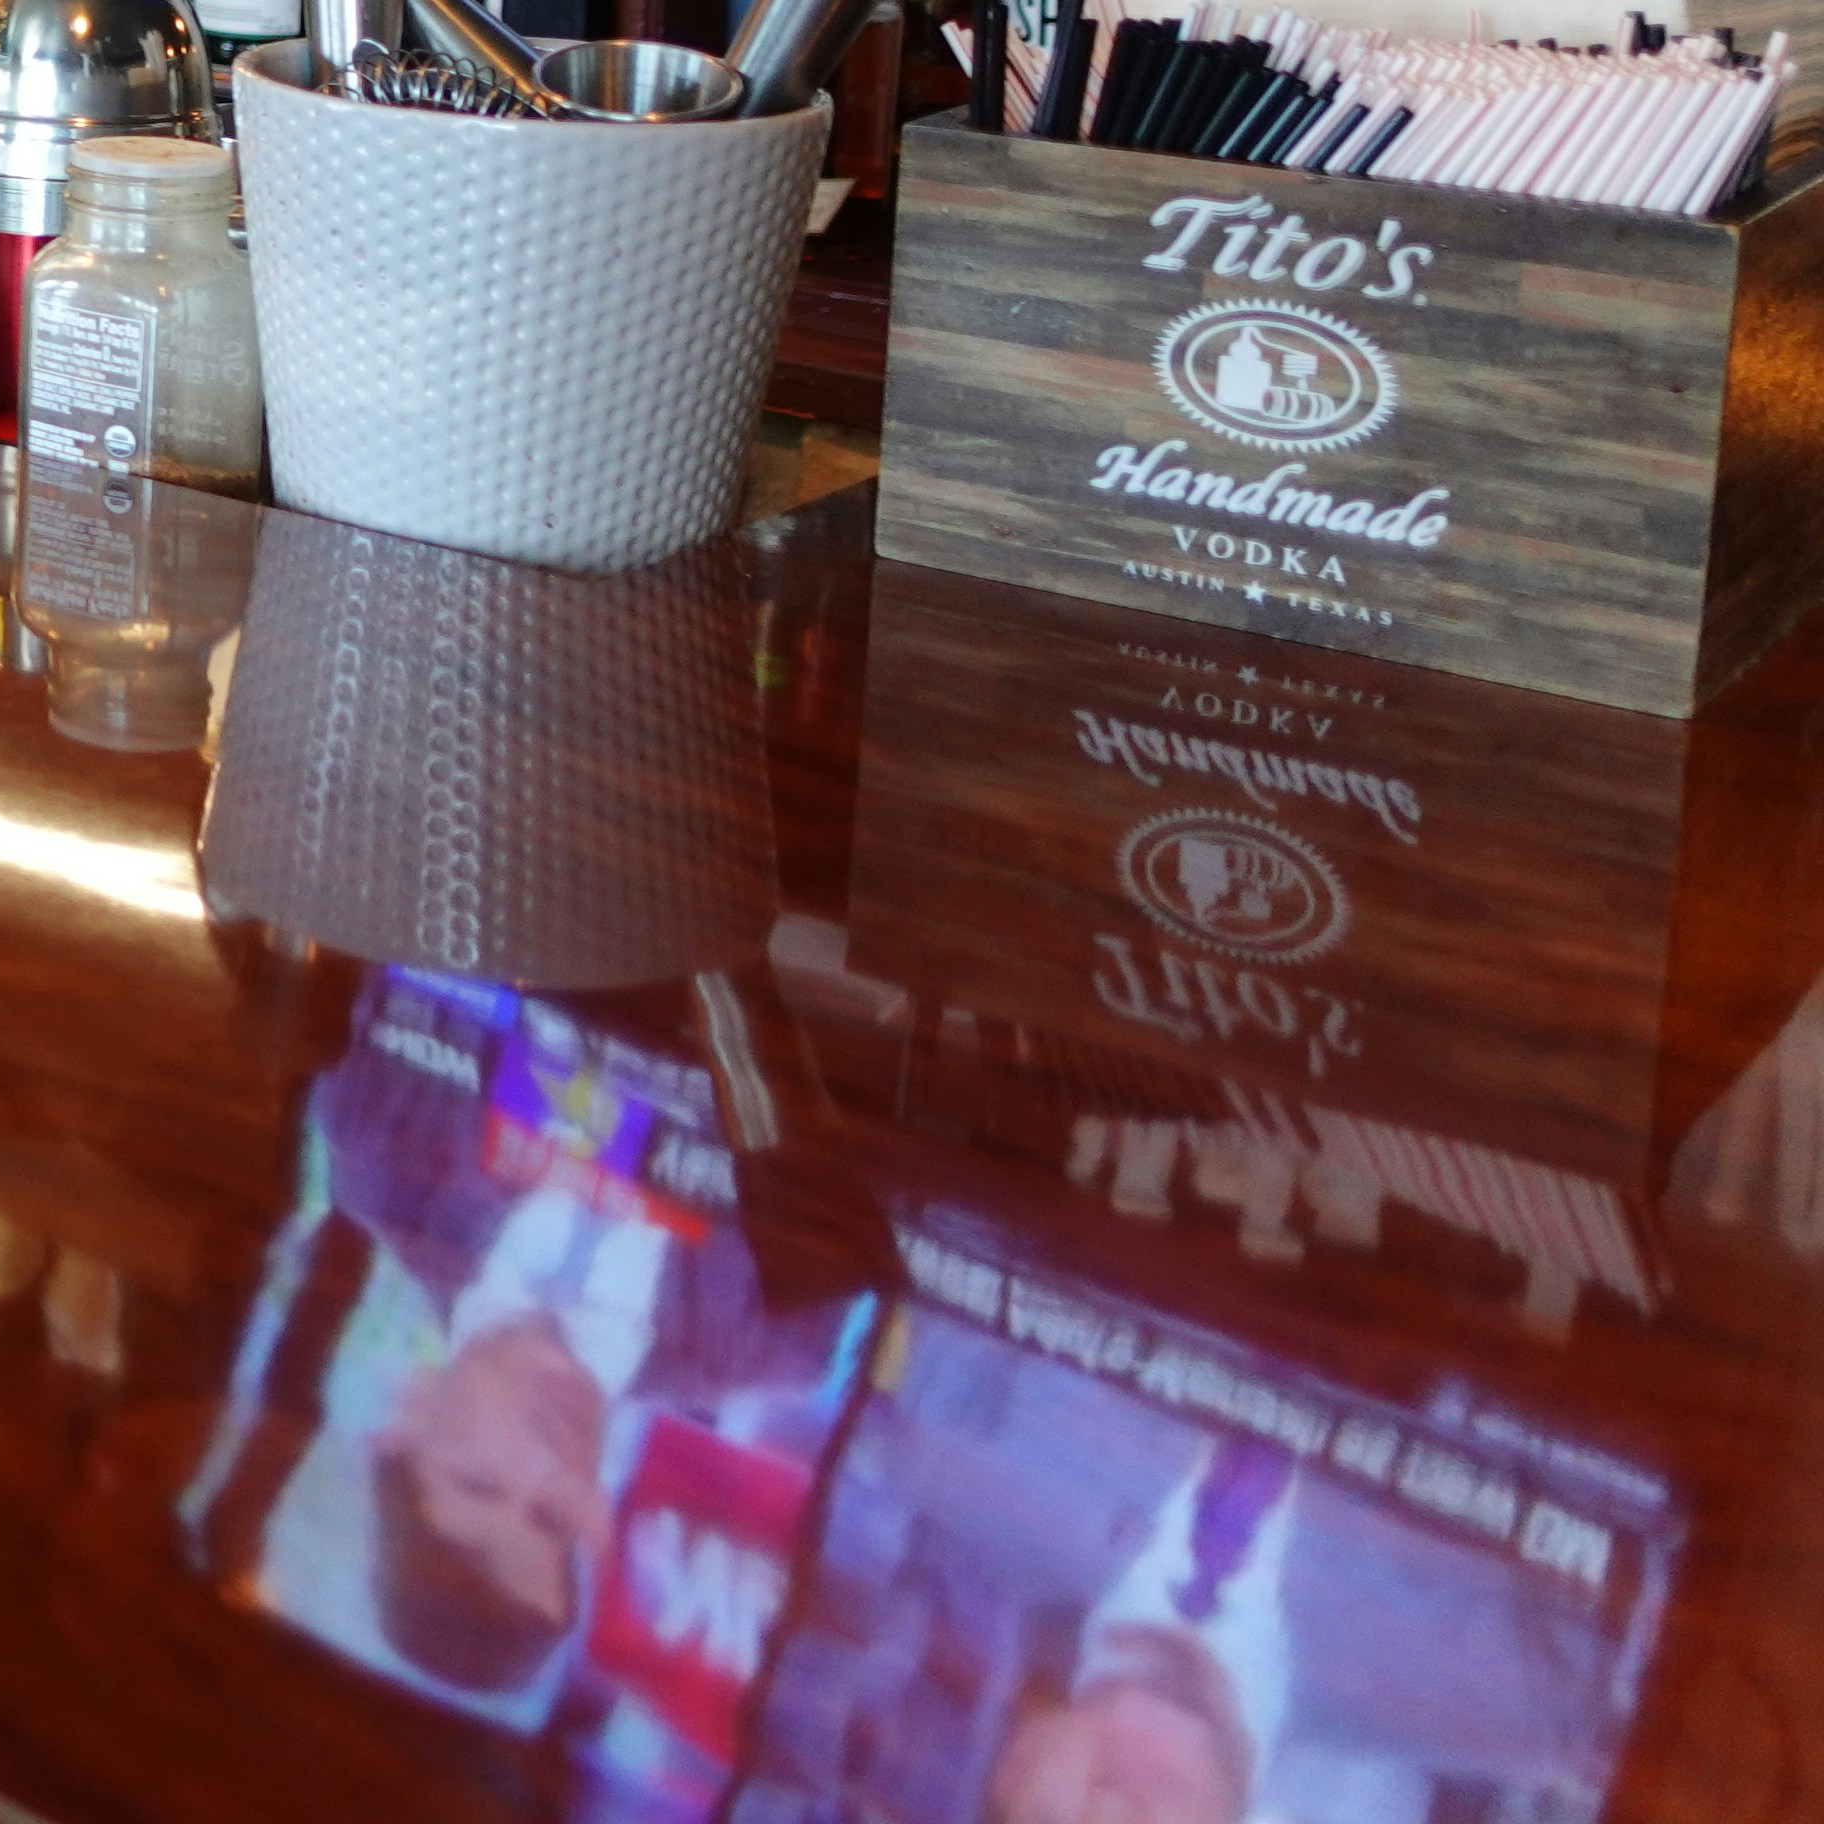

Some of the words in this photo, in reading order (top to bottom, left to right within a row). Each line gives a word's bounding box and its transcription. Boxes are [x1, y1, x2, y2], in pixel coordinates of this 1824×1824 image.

[1088, 439, 1450, 549] Handmade
[1172, 525, 1348, 585] VODKA
[1122, 559, 1228, 594] AUSTIN
[1287, 592, 1395, 628] TEXAS
